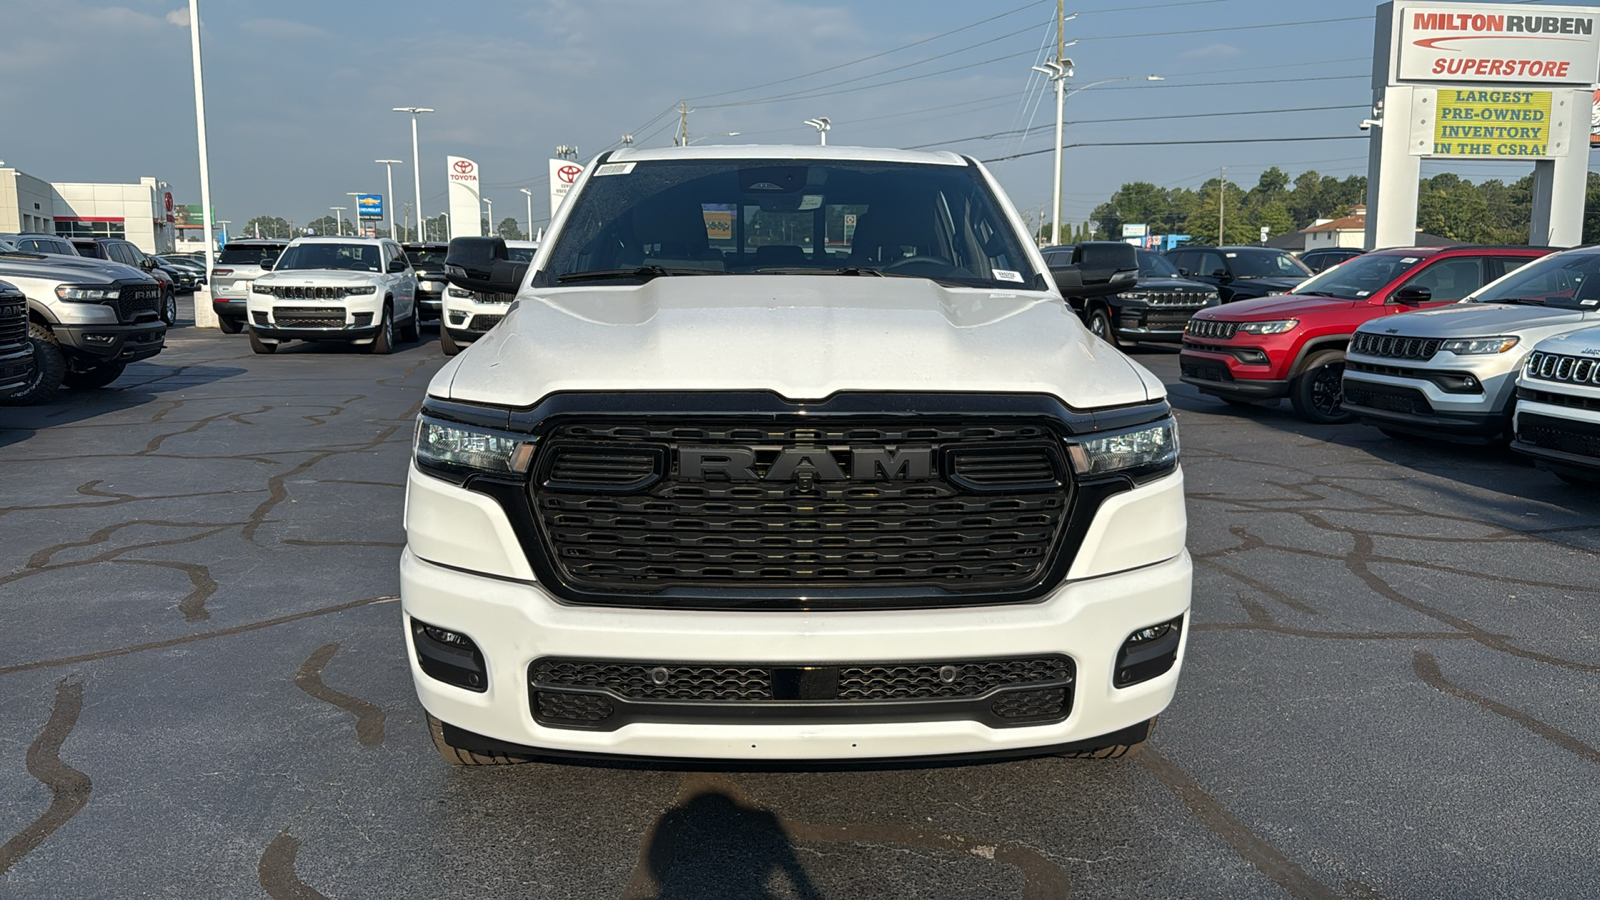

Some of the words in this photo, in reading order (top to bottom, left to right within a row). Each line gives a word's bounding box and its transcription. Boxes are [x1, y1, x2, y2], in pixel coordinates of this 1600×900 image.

[1432, 58, 1570, 77] SUPERSTORE
[1455, 90, 1533, 104] LARGEST
[1441, 108, 1544, 121] PRE-OWNED
[1441, 126, 1542, 139] INVENTORY
[1433, 143, 1451, 154] IN
[1457, 143, 1491, 155] THE
[1497, 144, 1547, 156] CSRA!
[0, 305, 22, 316] AM
[678, 444, 933, 482] RAM
